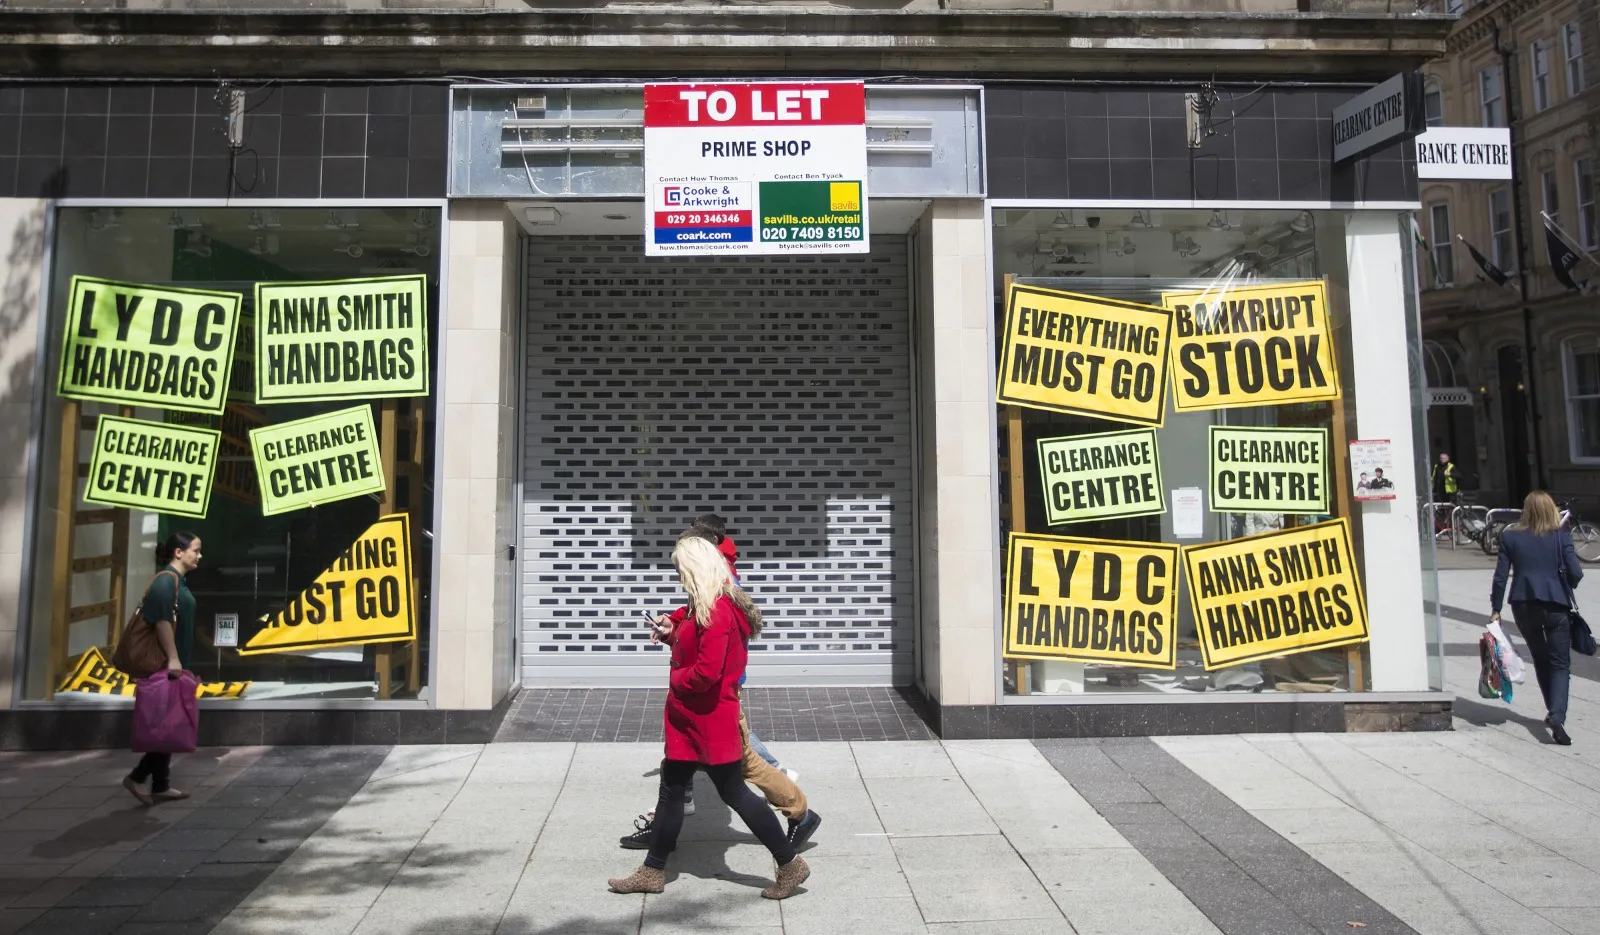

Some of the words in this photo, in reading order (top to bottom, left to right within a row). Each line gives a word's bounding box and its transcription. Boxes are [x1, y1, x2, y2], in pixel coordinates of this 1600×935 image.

[680, 90, 737, 121] TO
[751, 90, 829, 120] LET
[1334, 108, 1372, 146] CLEARANCE
[1373, 91, 1403, 128] CENTRE
[701, 141, 757, 157] PRIME
[763, 140, 811, 156] SHOP
[1462, 143, 1508, 165] CENTRE
[683, 186, 718, 195] Cooke
[722, 186, 730, 194] &
[683, 197, 739, 207] Arkwright
[832, 201, 858, 210] savills
[667, 215, 686, 224] 029
[688, 215, 701, 223] 20
[704, 214, 740, 223] 346346
[677, 231, 731, 240] coark.com
[762, 227, 787, 239] 020
[790, 227, 824, 239] 7409
[827, 226, 860, 239] 8150
[764, 214, 860, 224] savills.co.uk/retail
[267, 296, 331, 335] ANNA
[337, 291, 413, 332] SMITH
[1018, 306, 1160, 356] EVERYTHING
[1175, 294, 1316, 338] BANKRUPT
[71, 343, 217, 401] HANDBAGS
[267, 337, 415, 386] HANDBAGS
[1011, 343, 1105, 395] MUST
[1111, 359, 1156, 403] GO
[1179, 334, 1329, 398] STOCK
[103, 429, 209, 467] CLEARANCE
[263, 422, 367, 462] CLEARANCE
[1048, 441, 1152, 475] CLEARANCE
[1217, 438, 1320, 465] CLEARANCE
[97, 461, 204, 503] CENTRE
[269, 449, 374, 498] CENTRE
[1053, 472, 1156, 512] CENTRE
[1218, 470, 1320, 502] CENTRE
[328, 536, 397, 573] HING
[1199, 552, 1264, 599] ANNA
[1265, 537, 1342, 587] SMITH
[355, 575, 400, 620] GO
[1205, 583, 1354, 650] HANDBAGS
[219, 621, 235, 629] SALE
[1016, 603, 1164, 655] HANDBAGS
